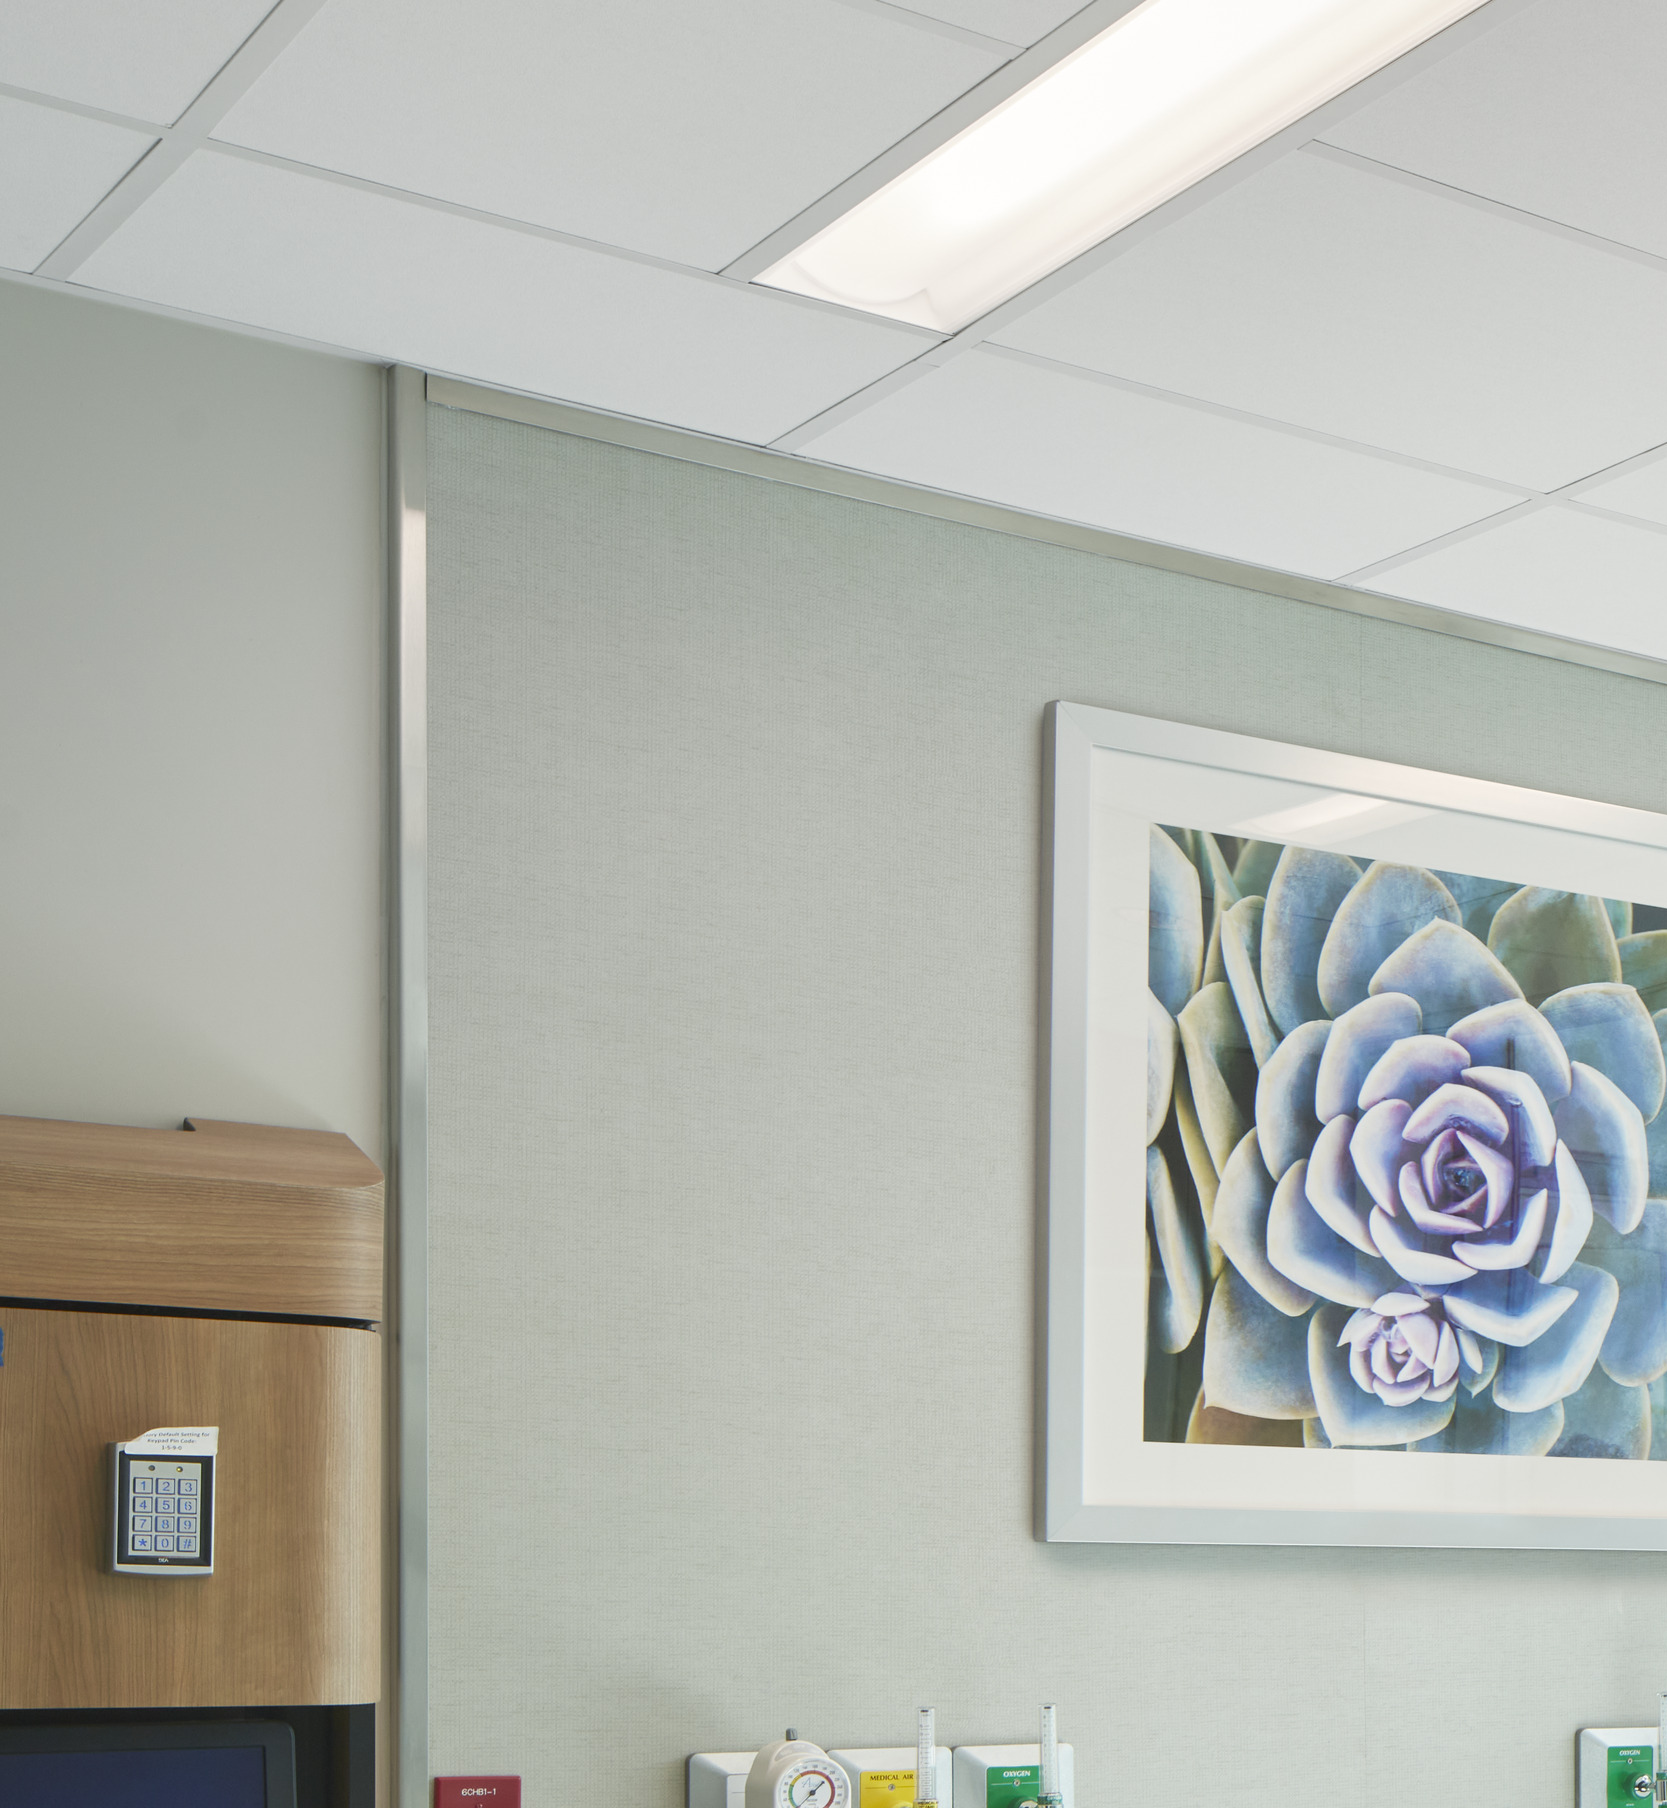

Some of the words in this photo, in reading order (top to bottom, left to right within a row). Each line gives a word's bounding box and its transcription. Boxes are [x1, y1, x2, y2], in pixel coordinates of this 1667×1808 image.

[141, 1481, 146, 1490] 1
[162, 1481, 170, 1491] 2
[185, 1482, 192, 1492] 3
[139, 1500, 147, 1510] 4
[162, 1500, 170, 1510] 5
[184, 1501, 192, 1511] 6
[140, 1519, 146, 1528] 7
[162, 1520, 169, 1529] 8
[184, 1520, 191, 1530] 9
[461, 1788, 496, 1796] 6CHB1-1
